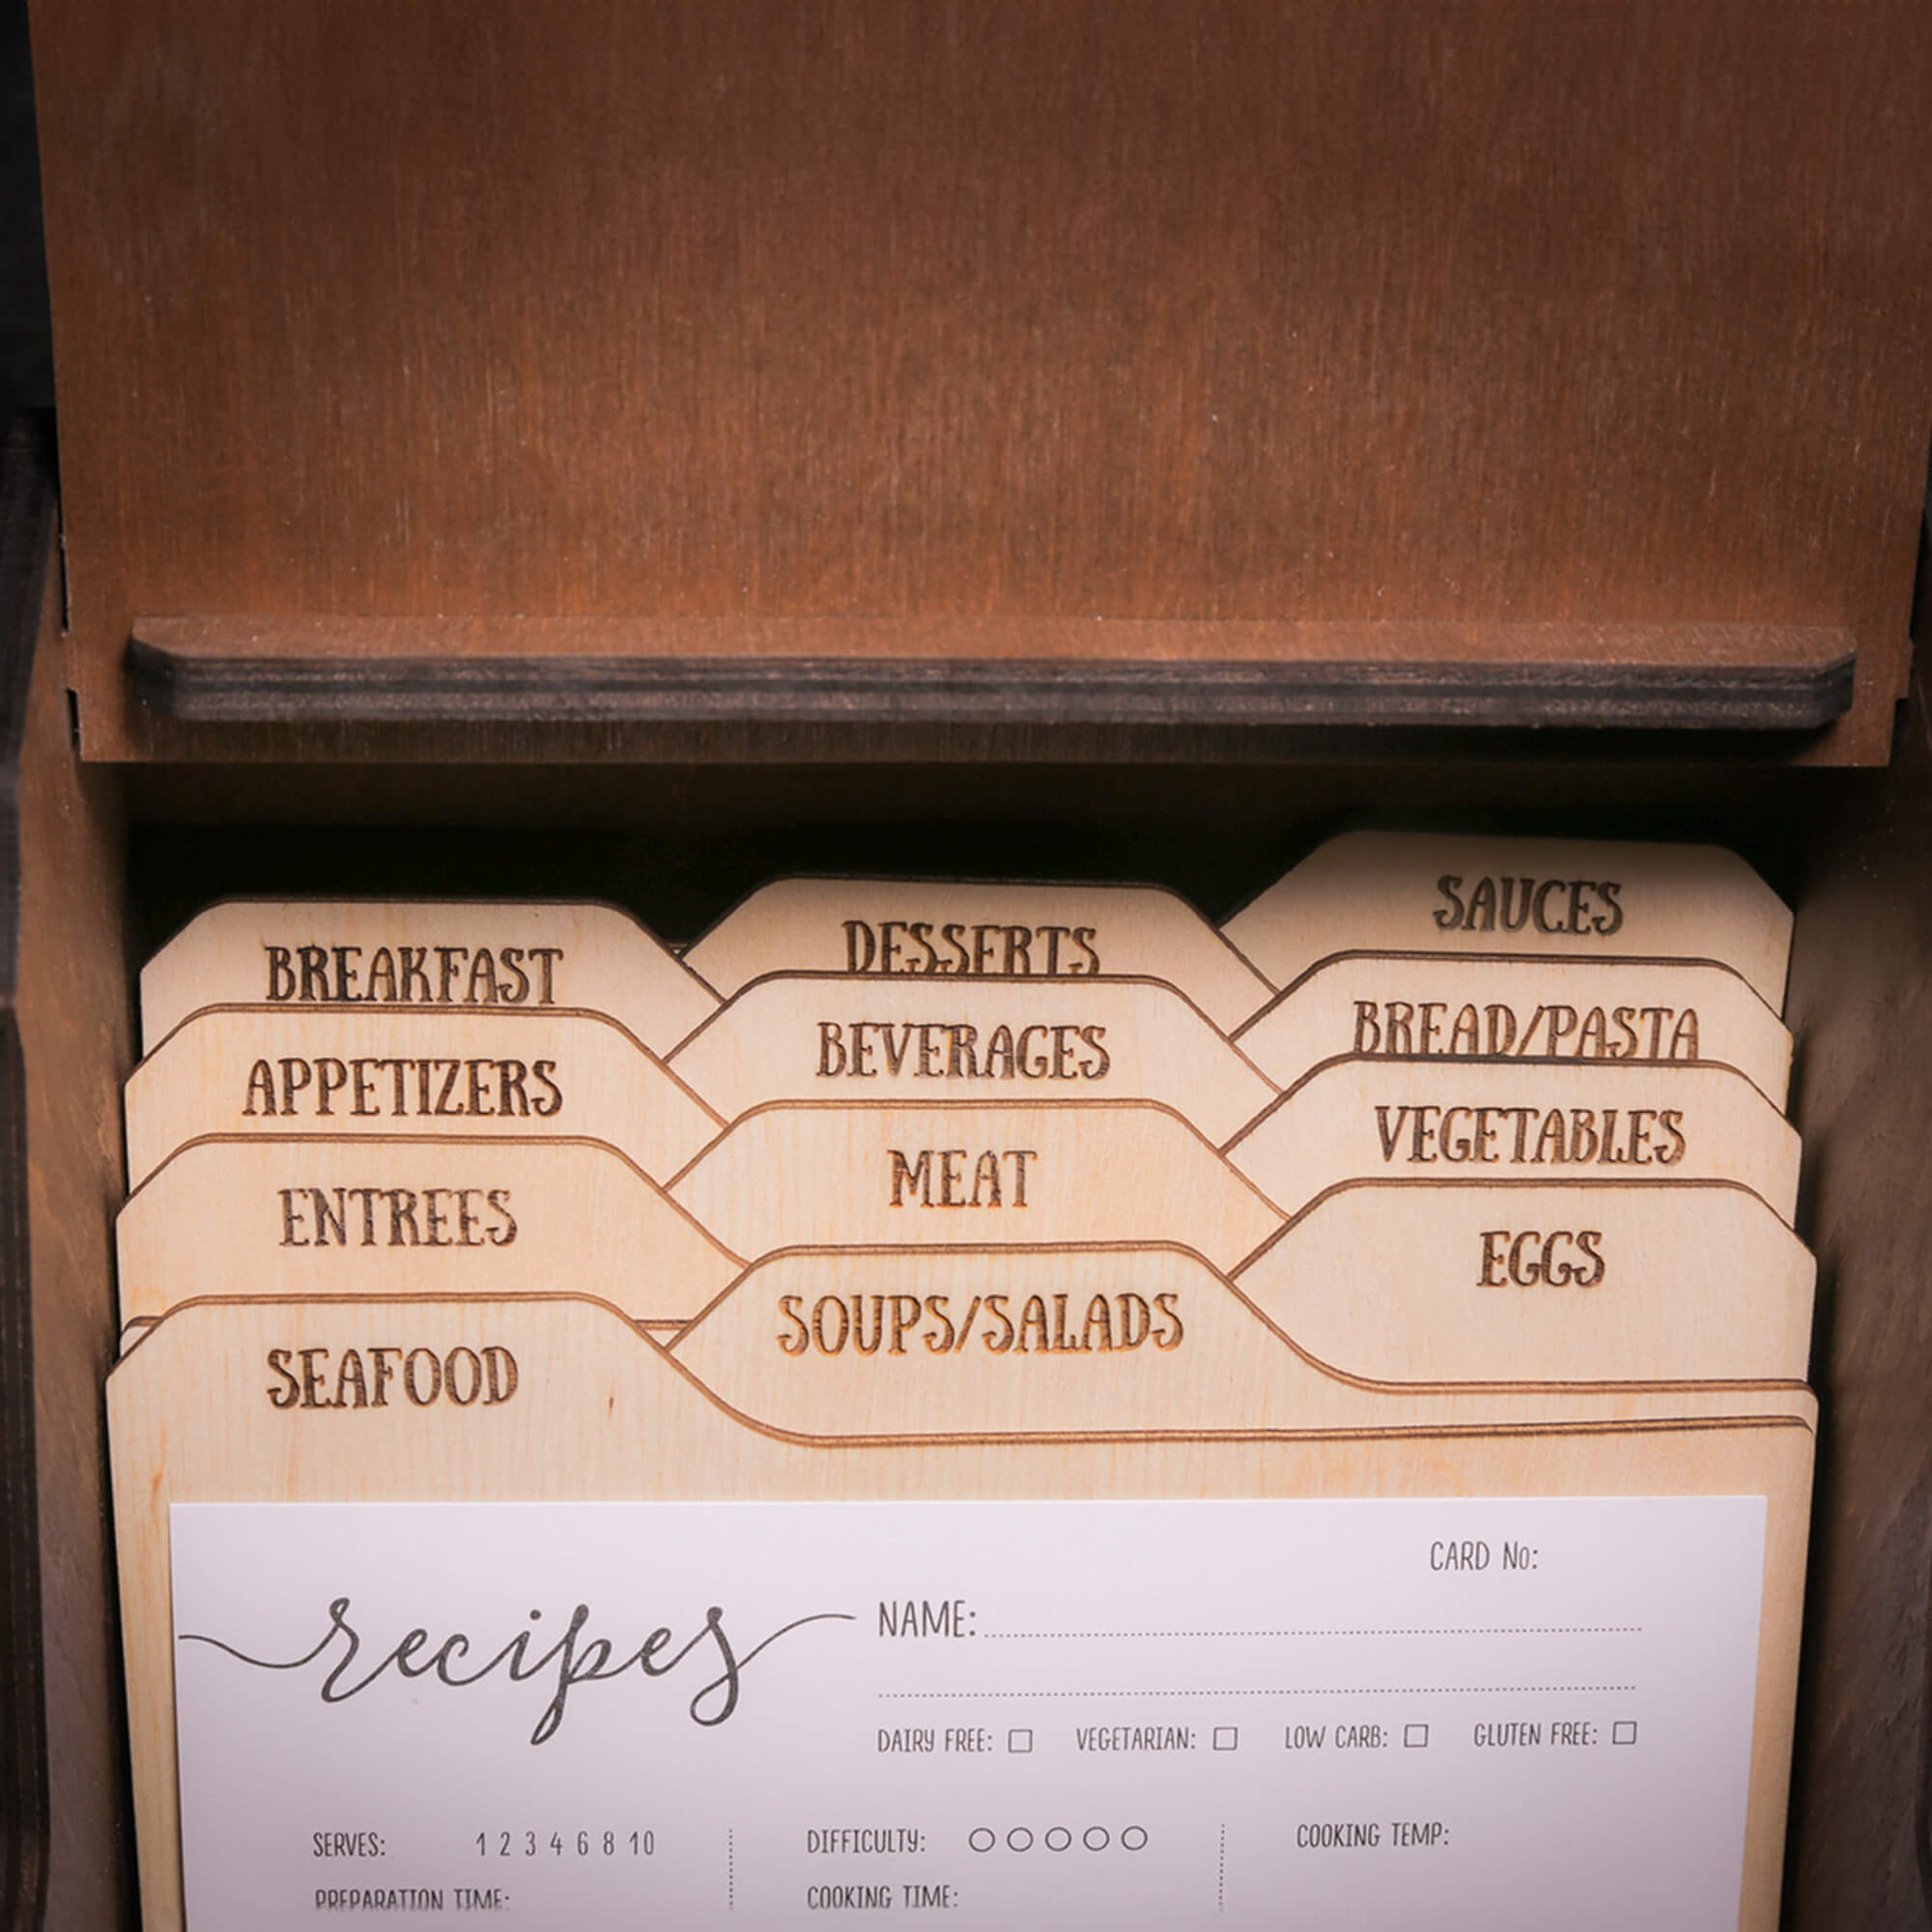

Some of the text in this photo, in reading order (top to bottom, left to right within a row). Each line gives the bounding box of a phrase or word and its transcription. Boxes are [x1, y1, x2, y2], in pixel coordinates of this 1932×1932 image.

[1433, 873, 1624, 937] SAUCES
[265, 944, 564, 1005] BREAKFAST
[841, 920, 1099, 974] DESSERTS
[815, 1021, 1111, 1080] BEVERAGES
[1353, 1000, 1699, 1060] BREAD/PASTA
[242, 1057, 563, 1118] APPETIZERS
[1374, 1105, 1686, 1166] VEGETABLES
[887, 1149, 1038, 1208] MEAT
[277, 1186, 518, 1247] ENTREES
[1475, 1230, 1605, 1289] EGGS
[778, 1292, 1184, 1355] SOUPS/SALADS
[266, 1346, 519, 1410] SEAFOOD
[1430, 1541, 1491, 1572] CARD
[879, 1600, 977, 1638] NAME:
[178, 1597, 857, 1746] recipes
[877, 1727, 993, 1753] DAIRY FREE:
[1076, 1726, 1196, 1751] VEGETARIAN:
[1285, 1724, 1388, 1749] LOW CARB:
[1473, 1721, 1598, 1747] GLUTEN FREE:
[312, 1830, 655, 1858] SERVES: 1 2 3 4 6 8 10
[807, 1828, 925, 1854] DIFFICULTY:
[1296, 1821, 1449, 1849] COOKING TEMP:
[315, 1888, 443, 1910] PREPARATION
[807, 1885, 958, 1910] COOKING TIME:
